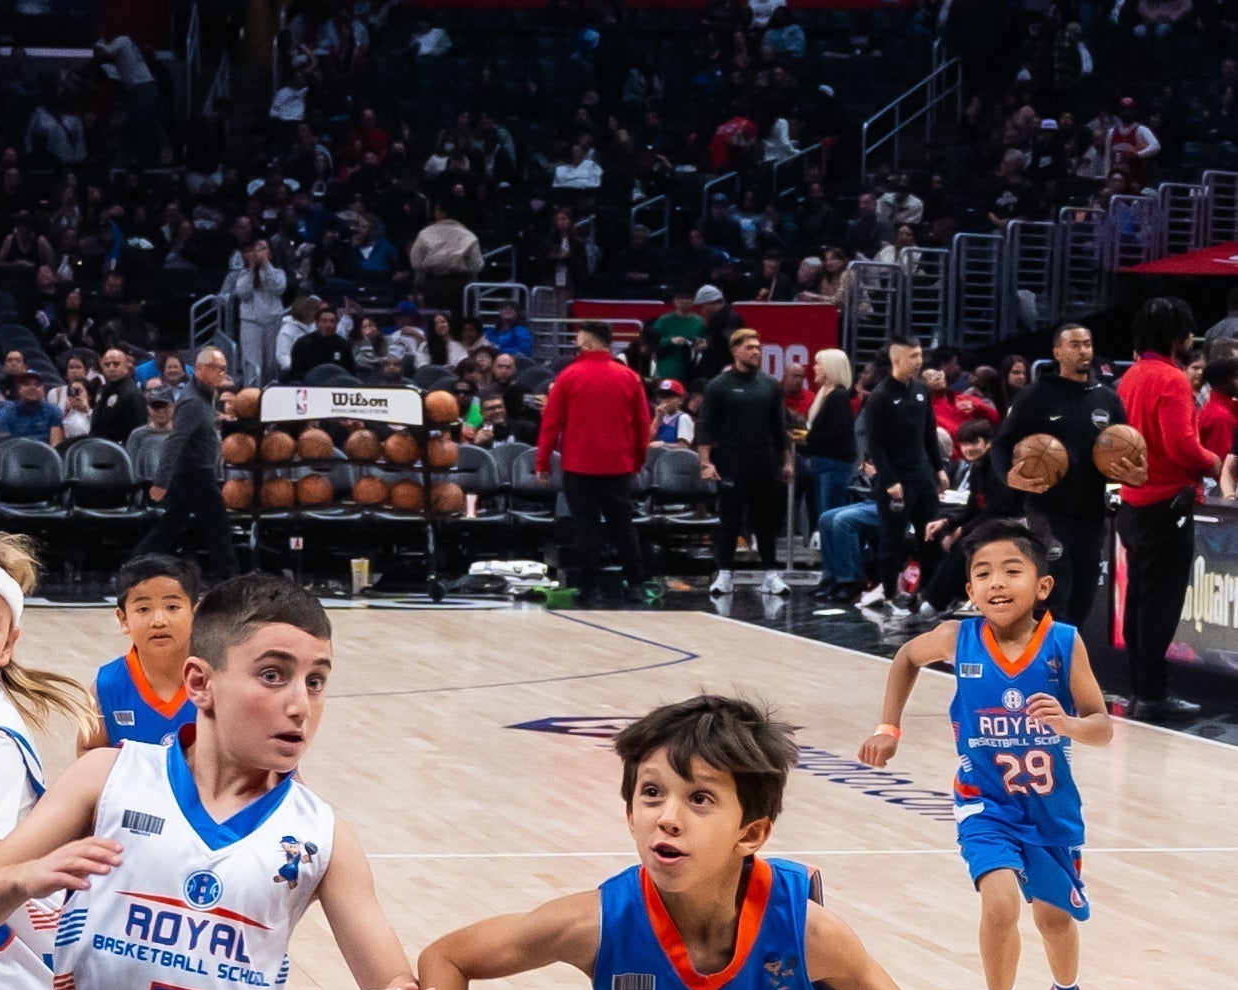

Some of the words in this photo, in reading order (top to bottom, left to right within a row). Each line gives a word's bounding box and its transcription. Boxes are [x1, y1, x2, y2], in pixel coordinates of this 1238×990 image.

[331, 392, 388, 407] Wilson
[994, 748, 1054, 796] 29
[92, 934, 208, 975] BASKETBALL
[124, 903, 251, 964] ROYAL
